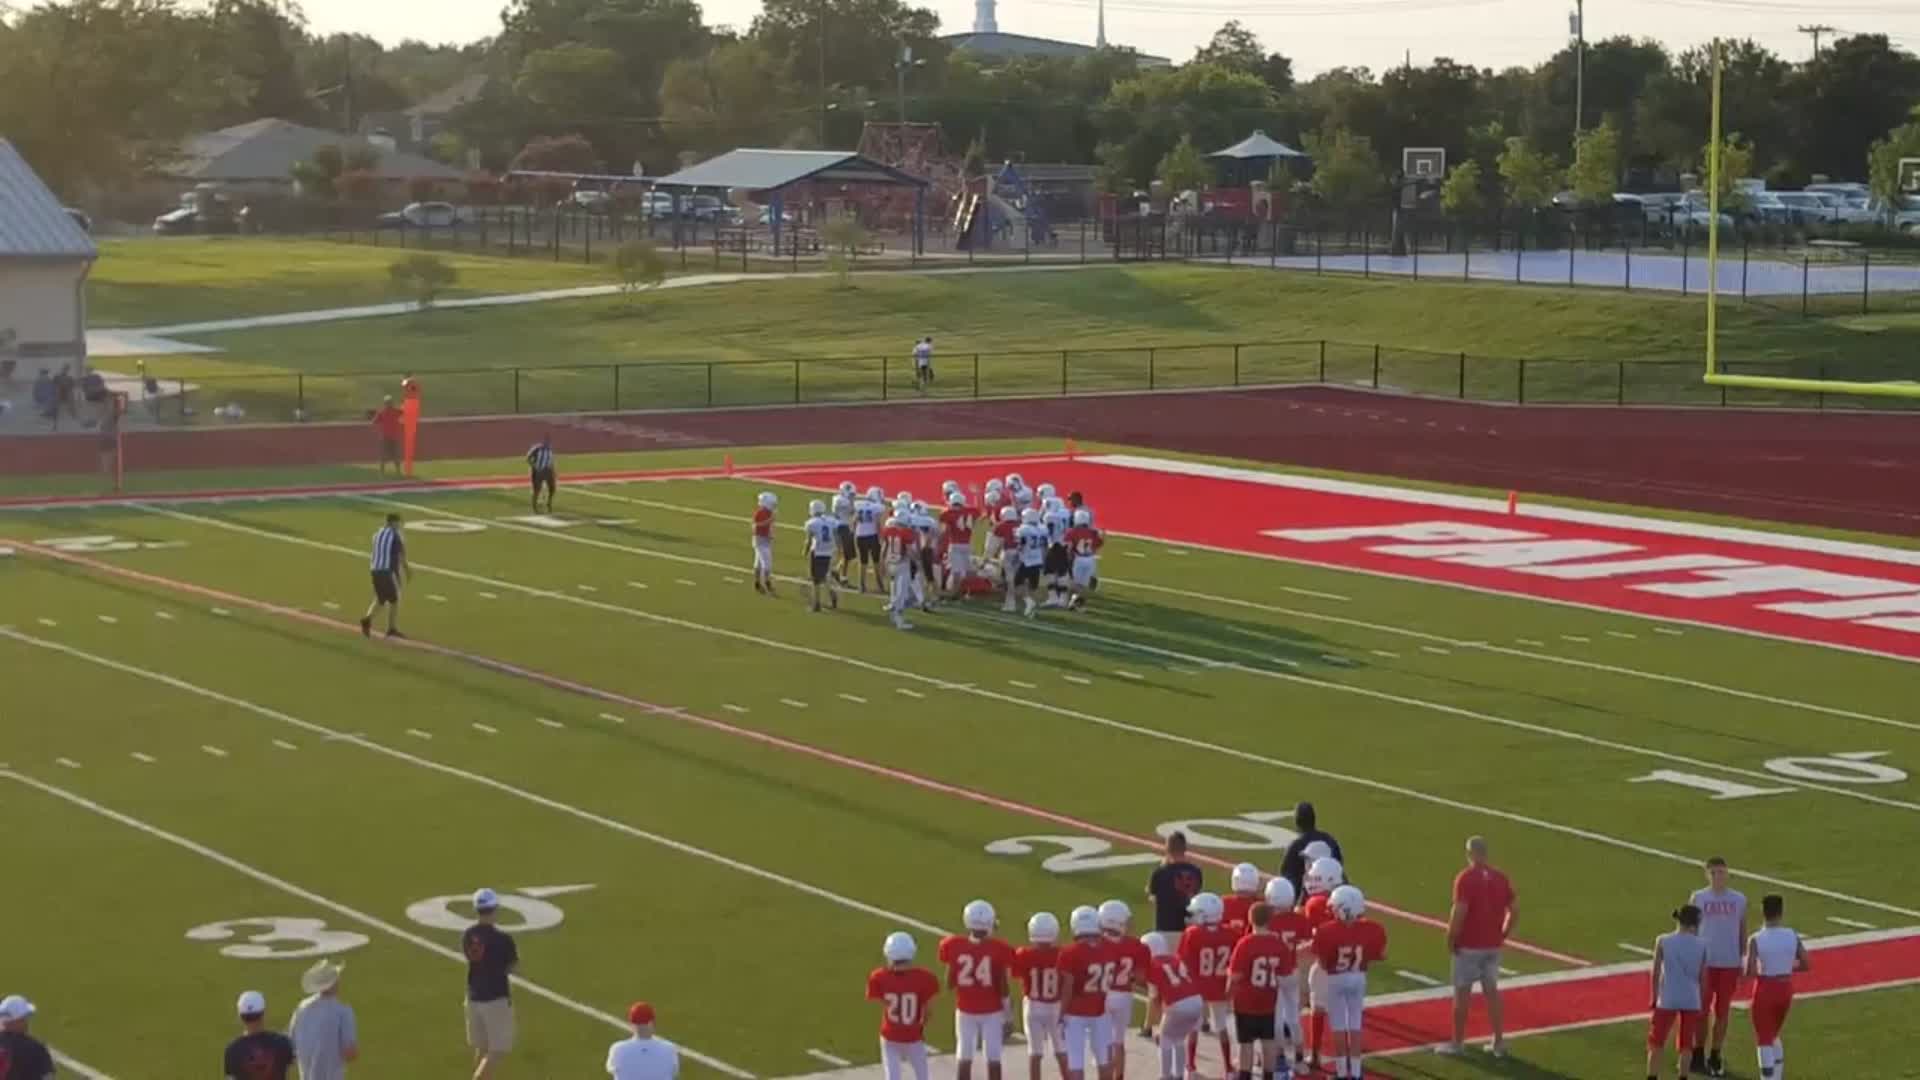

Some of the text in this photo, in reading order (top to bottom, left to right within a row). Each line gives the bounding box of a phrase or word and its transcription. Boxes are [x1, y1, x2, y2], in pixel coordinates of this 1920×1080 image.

[184, 893, 566, 958] 30
[956, 953, 993, 987] 24
[1199, 945, 1230, 977] 82
[1335, 945, 1363, 973] 51
[883, 991, 919, 1025] 20
